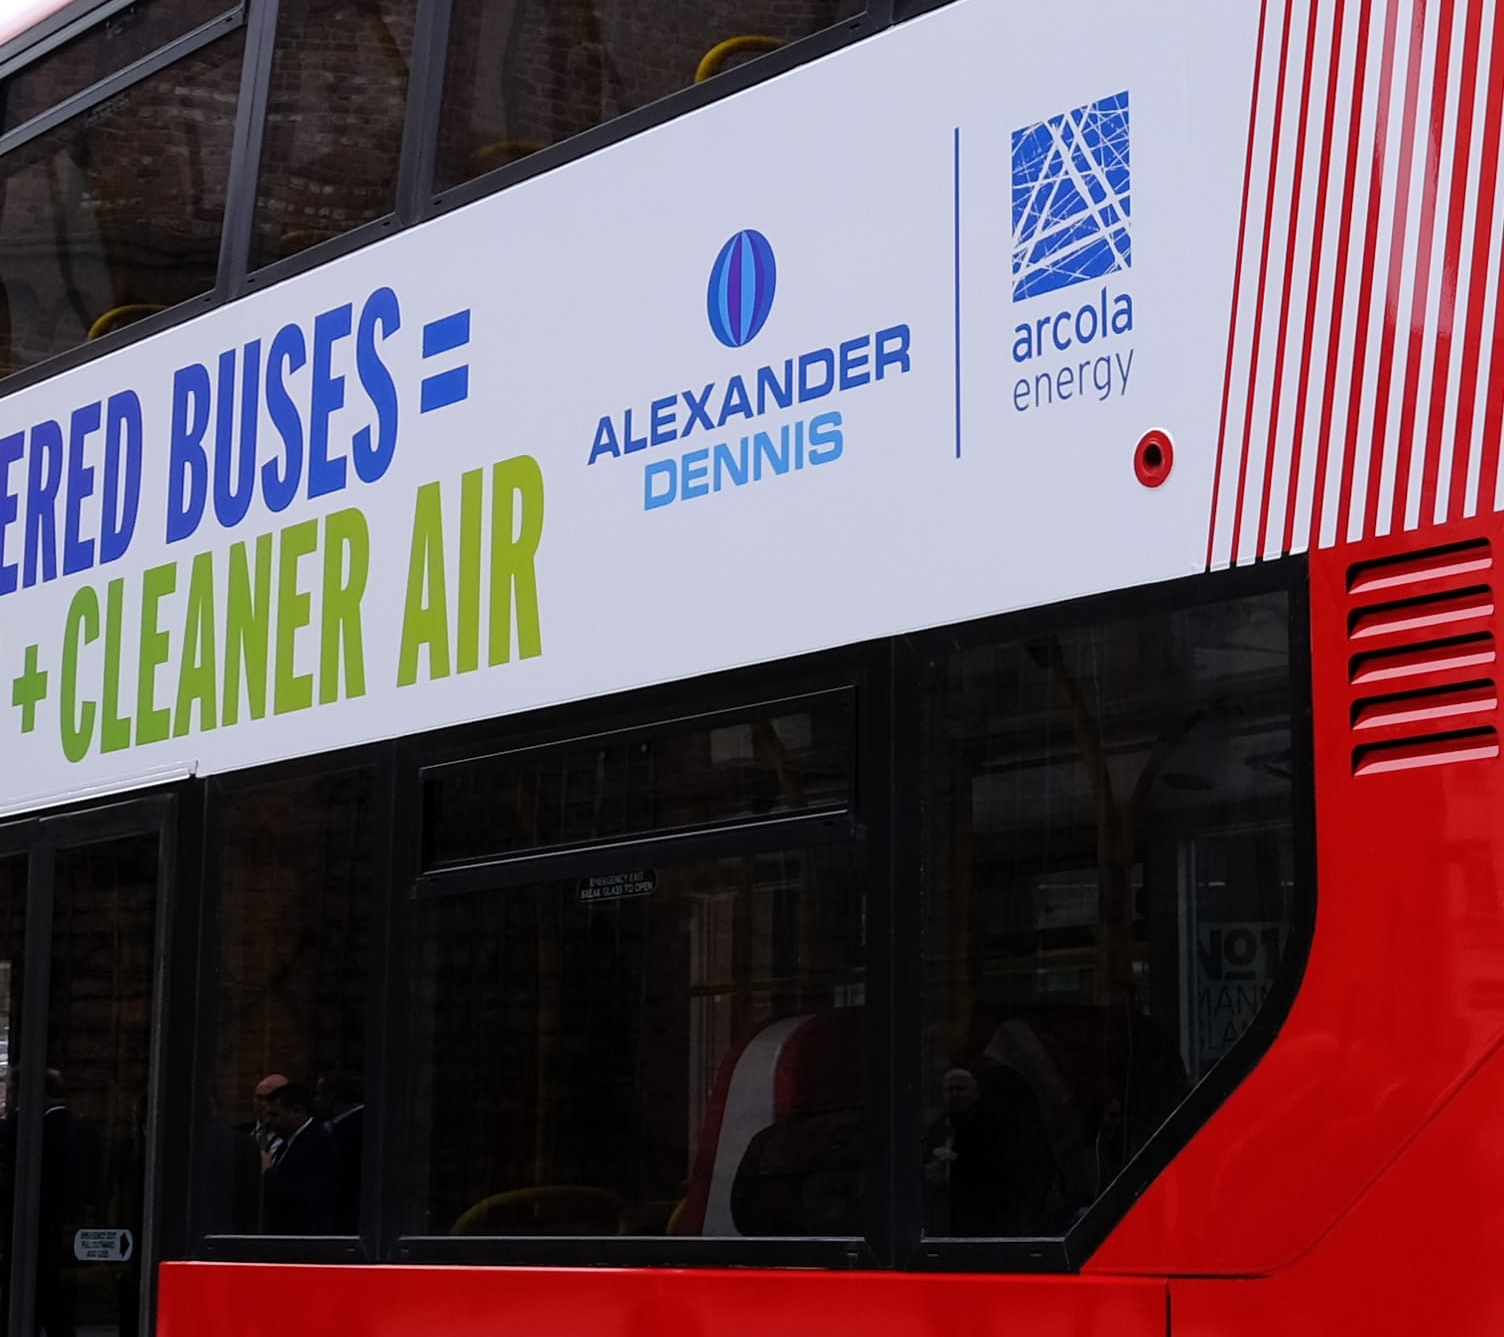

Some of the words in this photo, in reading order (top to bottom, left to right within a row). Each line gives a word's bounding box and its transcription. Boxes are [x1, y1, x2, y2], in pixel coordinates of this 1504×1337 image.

[1012, 286, 1134, 363] arcola
[587, 323, 911, 466] ALEXANDER
[1012, 348, 1135, 413] energy
[643, 410, 844, 511] DENNIS
[60, 507, 370, 764] CLEANER
[397, 454, 545, 688] AIR
